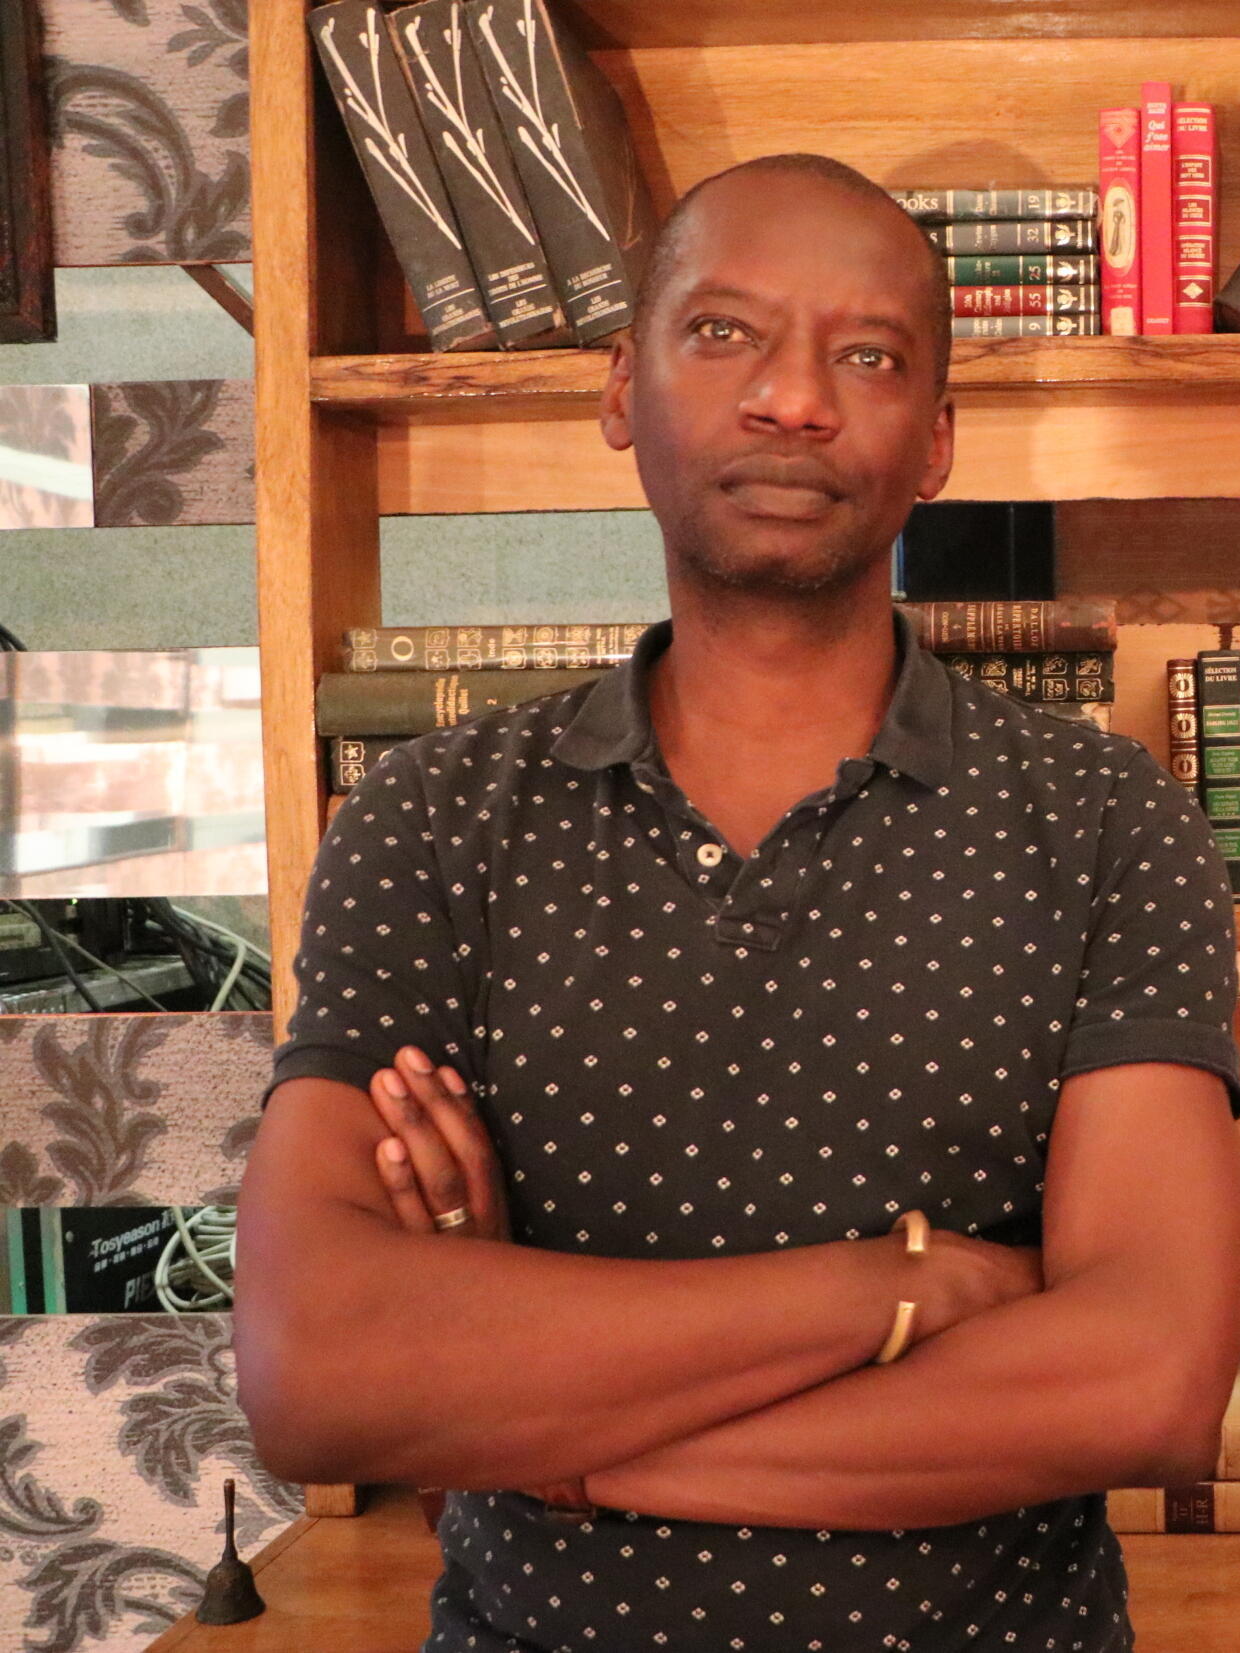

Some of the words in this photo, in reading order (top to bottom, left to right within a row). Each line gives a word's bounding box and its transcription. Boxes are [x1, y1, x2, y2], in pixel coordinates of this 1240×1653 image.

[896, 194, 938, 210] ooks
[1029, 195, 1040, 209] 19
[1027, 227, 1040, 243] 32
[1029, 293, 1041, 307] 55
[1029, 322, 1040, 331] 9
[1205, 666, 1237, 674] SÉLECTION
[459, 689, 470, 715] Quillet
[89, 1219, 160, 1258] Tosyeason
